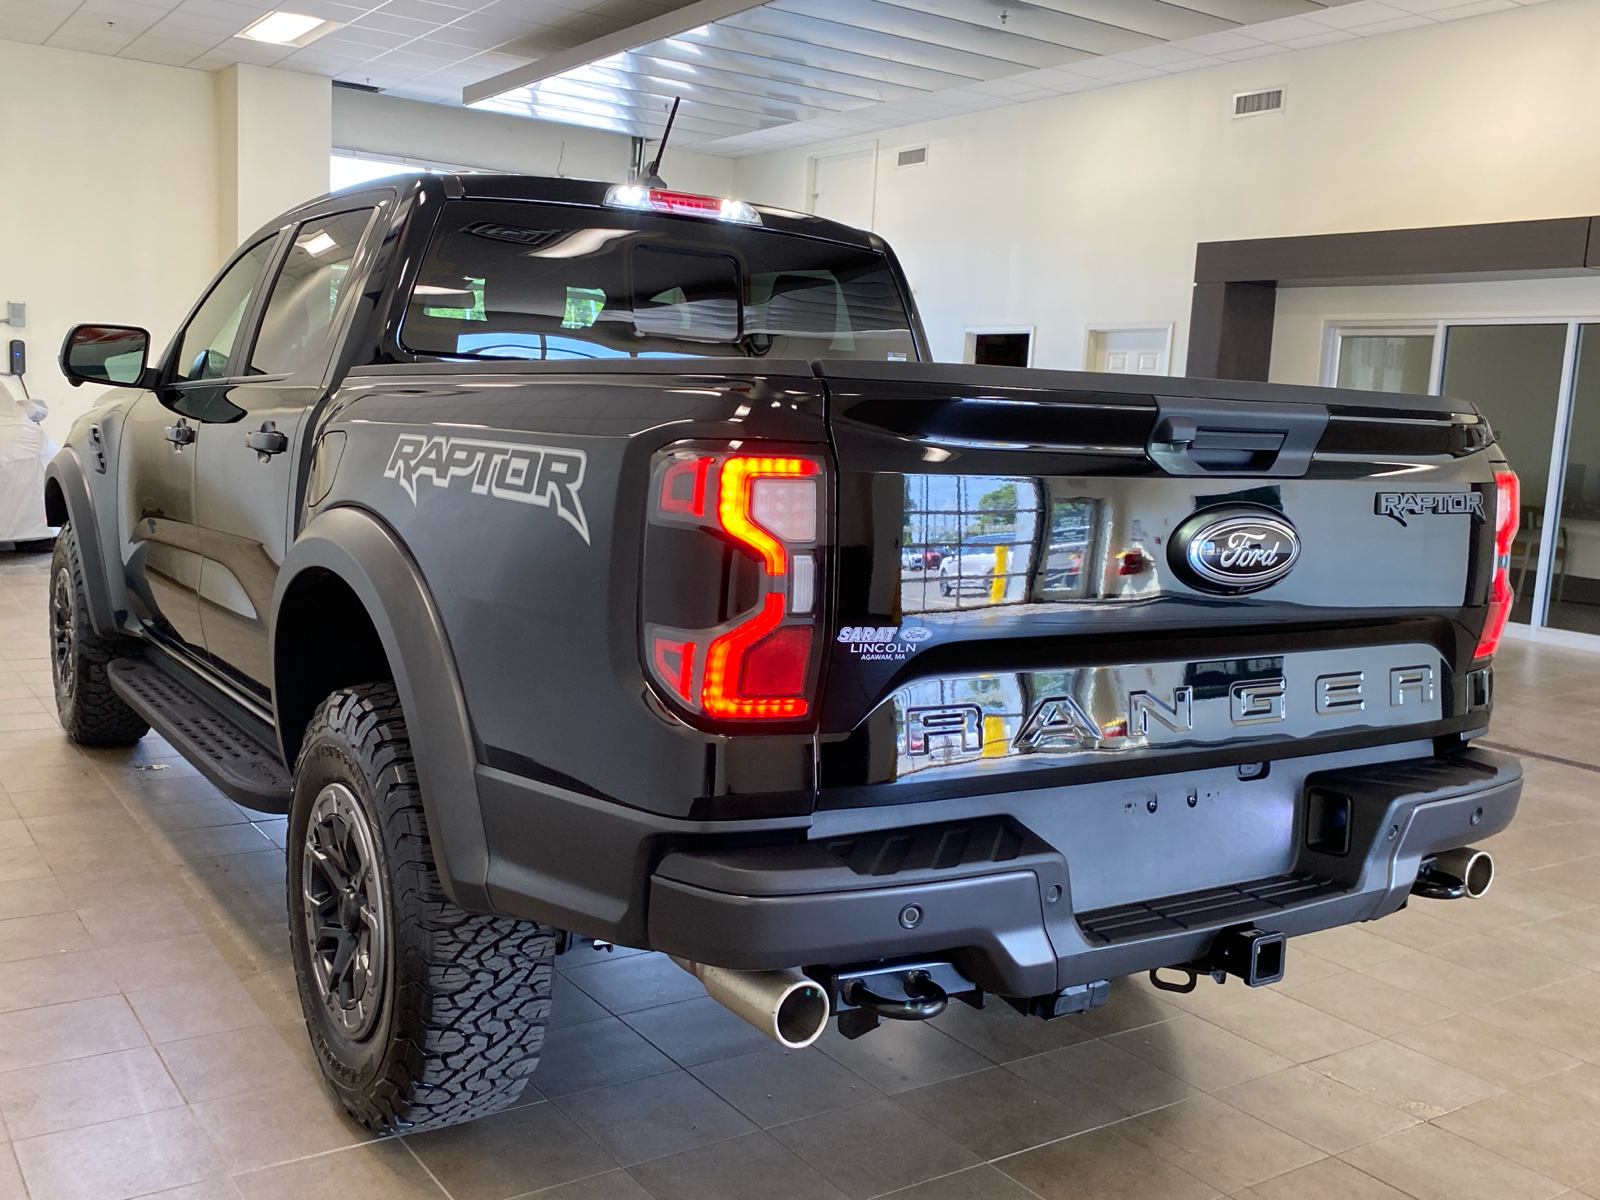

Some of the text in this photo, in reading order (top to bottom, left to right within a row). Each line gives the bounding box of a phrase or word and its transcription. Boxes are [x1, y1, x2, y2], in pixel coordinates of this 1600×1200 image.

[383, 433, 590, 546] RAPTOR
[1375, 491, 1486, 527] RAPTOR
[1220, 532, 1280, 568] Ford
[837, 626, 898, 643] SARAT
[850, 643, 917, 653] LINCOLN
[860, 653, 893, 661] AGAWAM,
[905, 664, 1435, 757] RANGER
